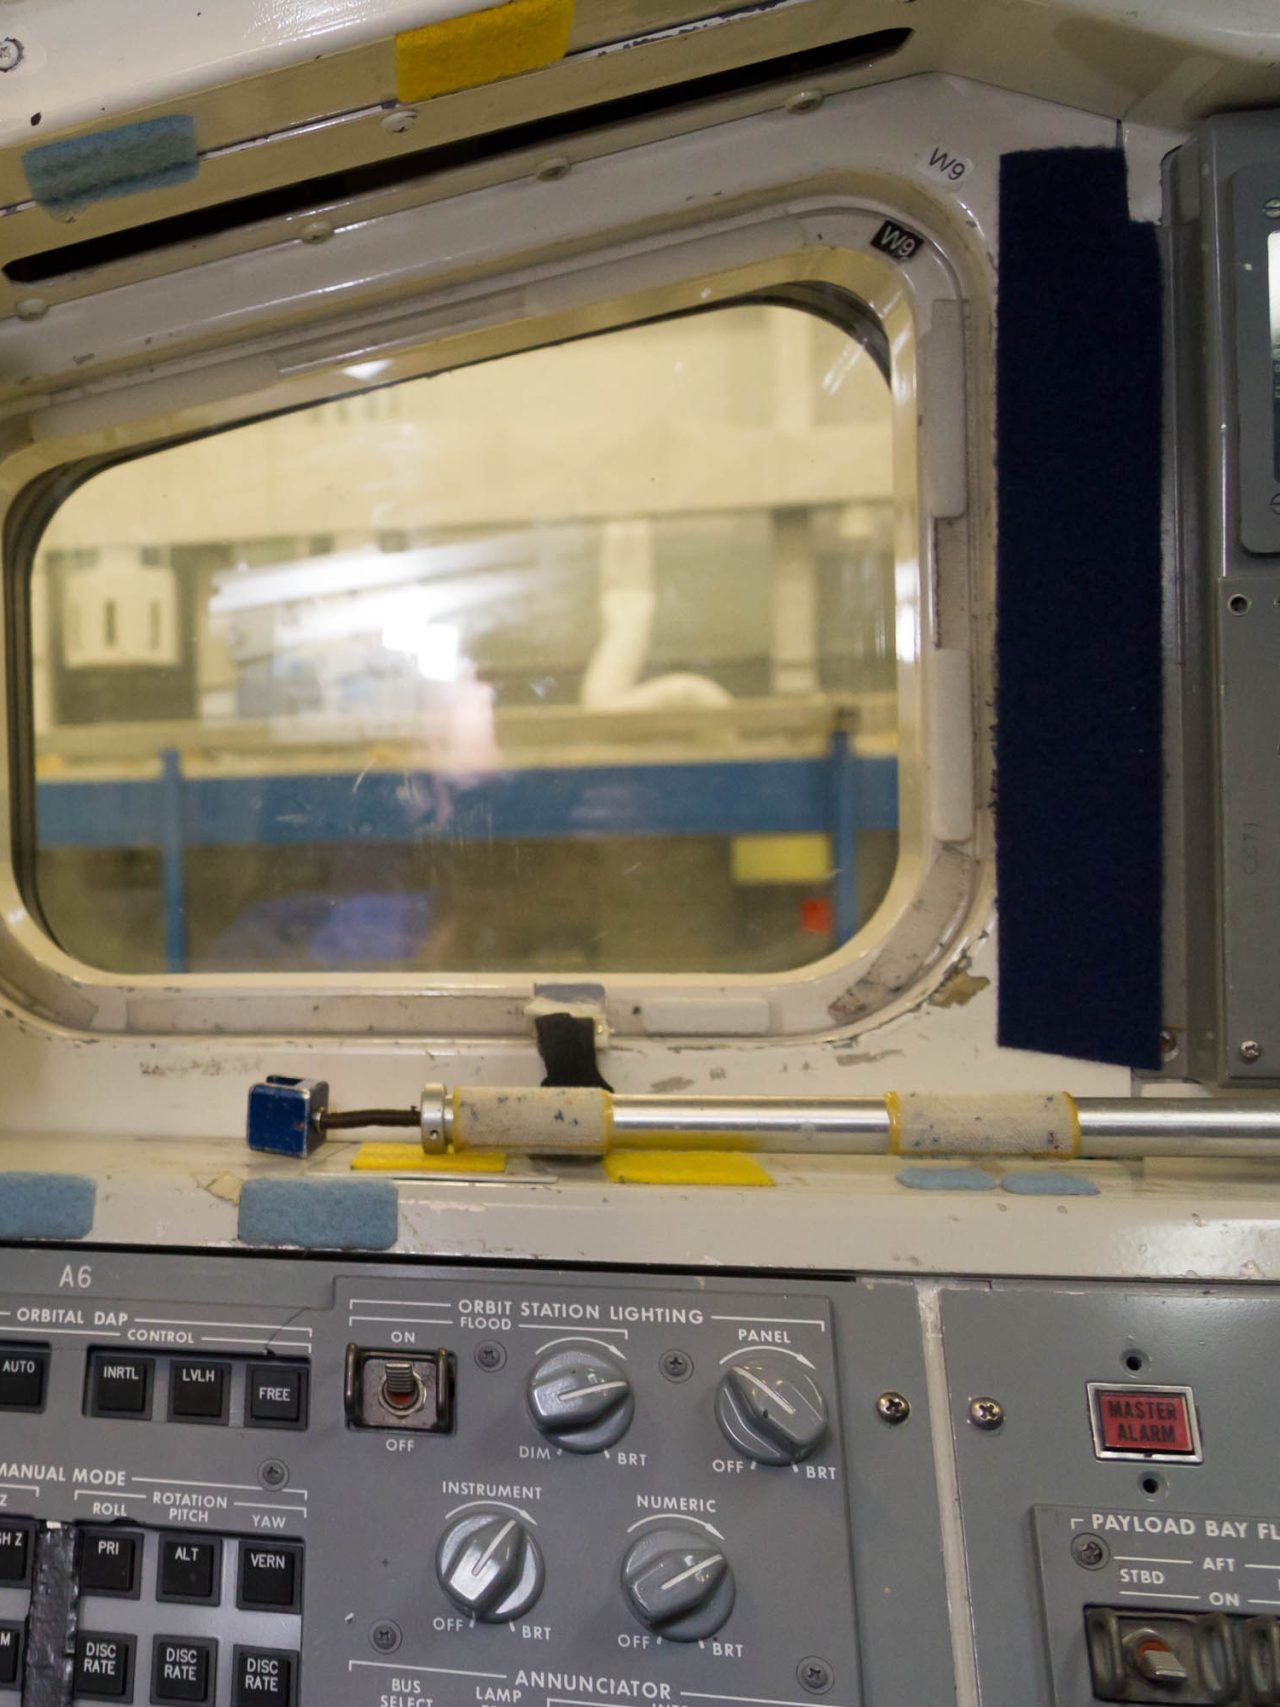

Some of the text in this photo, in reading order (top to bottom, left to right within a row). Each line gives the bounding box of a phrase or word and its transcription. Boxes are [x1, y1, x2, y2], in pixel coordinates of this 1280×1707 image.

[928, 147, 966, 182] W9
[881, 227, 916, 256] W9
[59, 1264, 93, 1289] A6
[16, 1307, 129, 1328] ORBITAL DAP
[457, 1298, 704, 1326] ORBIT STATION LIGHTING
[460, 1315, 512, 1331] FLOOD
[127, 1328, 195, 1344] CONTROL
[390, 1331, 416, 1344] ON
[738, 1328, 792, 1344] PANEL
[2, 1359, 36, 1375] AUTO
[103, 1365, 140, 1380] INRTL
[182, 1367, 215, 1382] LVLH
[258, 1387, 291, 1402] FREE
[1107, 1400, 1177, 1421] MASTER
[1117, 1423, 1176, 1444] ALARM
[385, 1438, 415, 1453] OFF
[519, 1446, 552, 1460] DIM
[618, 1452, 648, 1468] BRT
[712, 1459, 745, 1474] OFF
[72, 1467, 126, 1486] MODE
[805, 1465, 836, 1481] BRT
[442, 1480, 543, 1500] INSTRUMENT
[152, 1490, 228, 1509] ROTATION
[636, 1494, 717, 1514] NUMERIC
[92, 1502, 128, 1517] ROLL
[169, 1507, 209, 1523] PITCH
[251, 1514, 287, 1529] YAW
[1091, 1513, 1196, 1536] PAYLOAD
[1205, 1519, 1248, 1538] BAY
[13, 1532, 23, 1547] Z
[97, 1540, 120, 1555] PRI
[174, 1546, 200, 1561] ALT
[251, 1552, 286, 1569] VERN
[1202, 1556, 1236, 1573] AFT
[1120, 1568, 1166, 1585] STBD
[1208, 1591, 1240, 1607] ON
[432, 1617, 464, 1632] OFF
[522, 1625, 551, 1641] BRT
[85, 1641, 117, 1658] DISC
[617, 1634, 651, 1650] OFF
[166, 1647, 198, 1664] DISC
[712, 1643, 744, 1659] BRT
[83, 1658, 117, 1675] RATE
[163, 1664, 198, 1681] RATE
[246, 1657, 278, 1674] DISC
[244, 1674, 278, 1692] RATE
[391, 1678, 421, 1694] BUS
[515, 1669, 672, 1700] ANNUNCIATOR
[475, 1686, 522, 1704] LAMP
